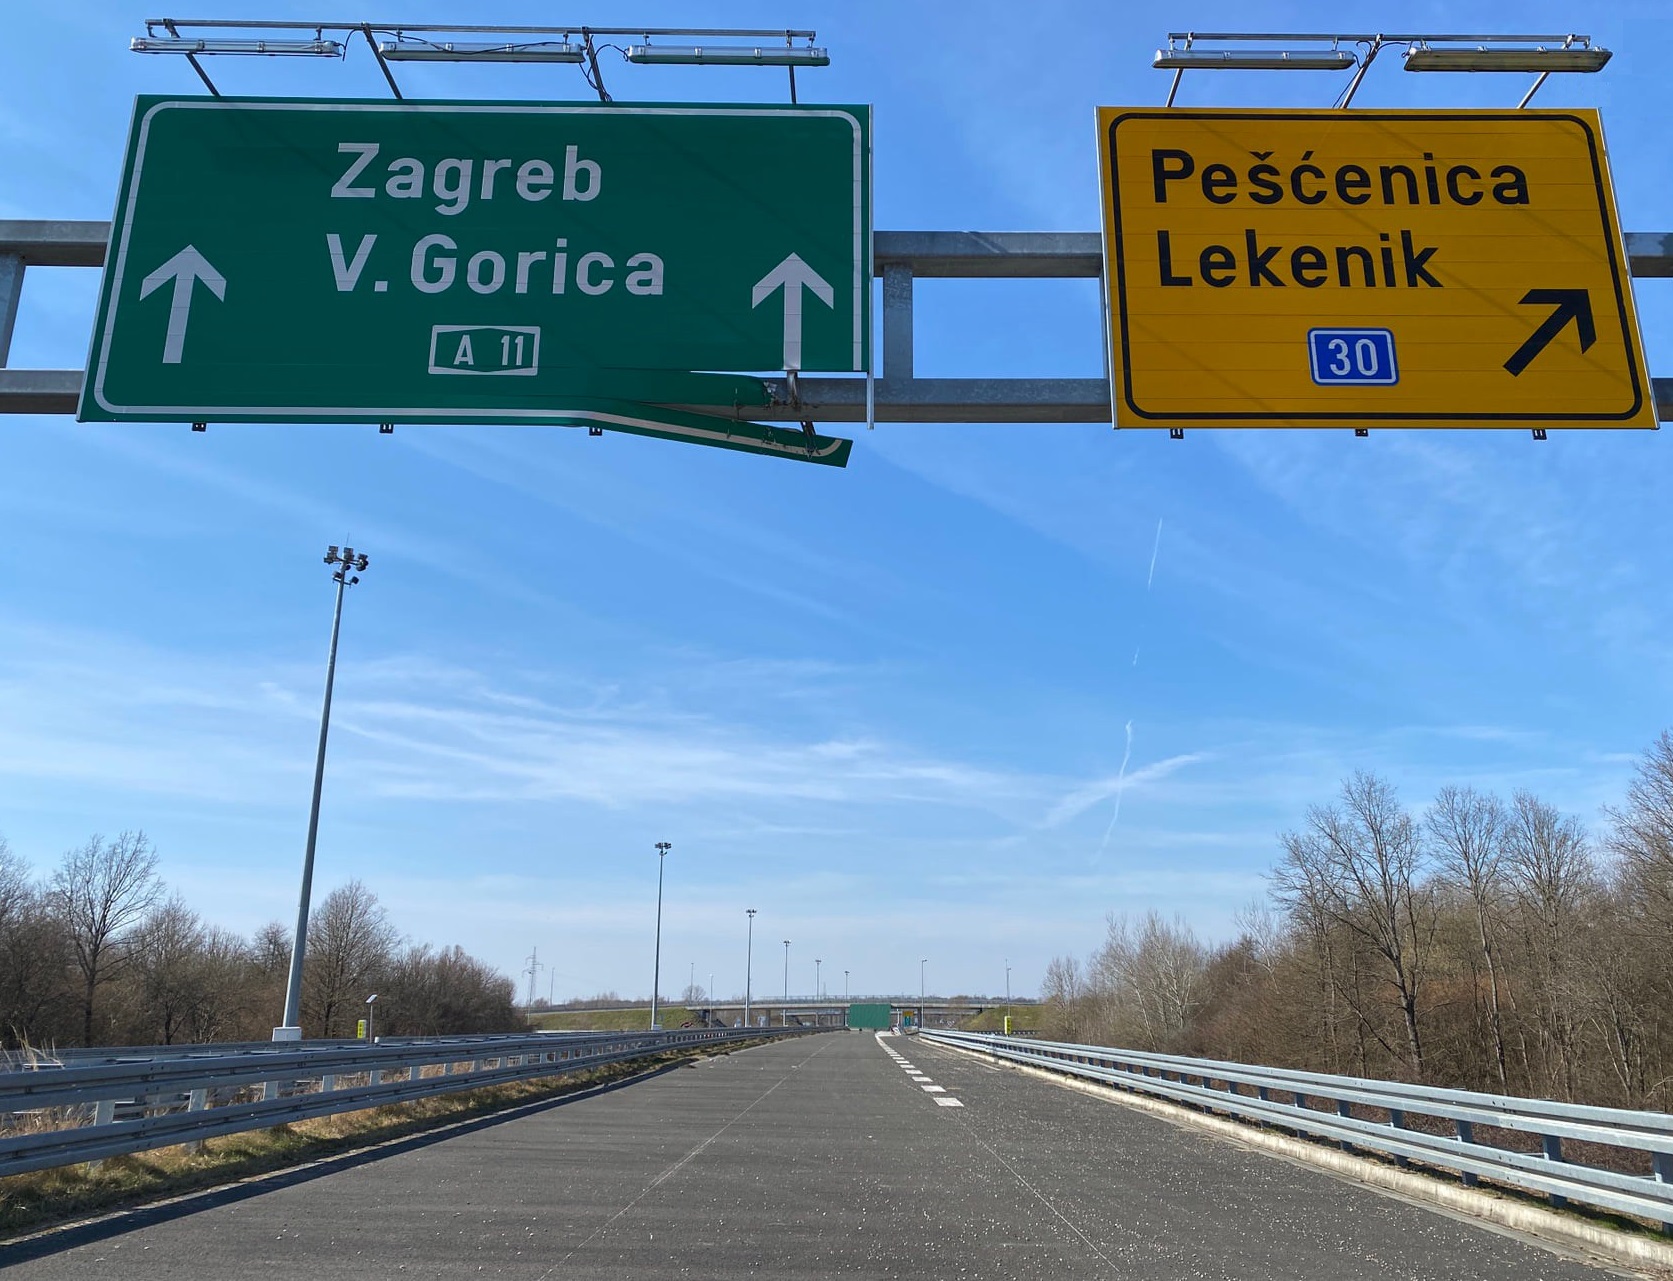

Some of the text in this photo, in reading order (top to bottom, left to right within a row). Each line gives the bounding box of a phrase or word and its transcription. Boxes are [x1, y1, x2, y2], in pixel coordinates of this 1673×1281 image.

[331, 143, 602, 215] Zagreb
[1152, 148, 1530, 206] Pešćenica
[326, 233, 664, 295] V. Gorica
[1157, 229, 1444, 288] Lekenik
[453, 334, 524, 366] A 11
[1328, 338, 1378, 376] 30
